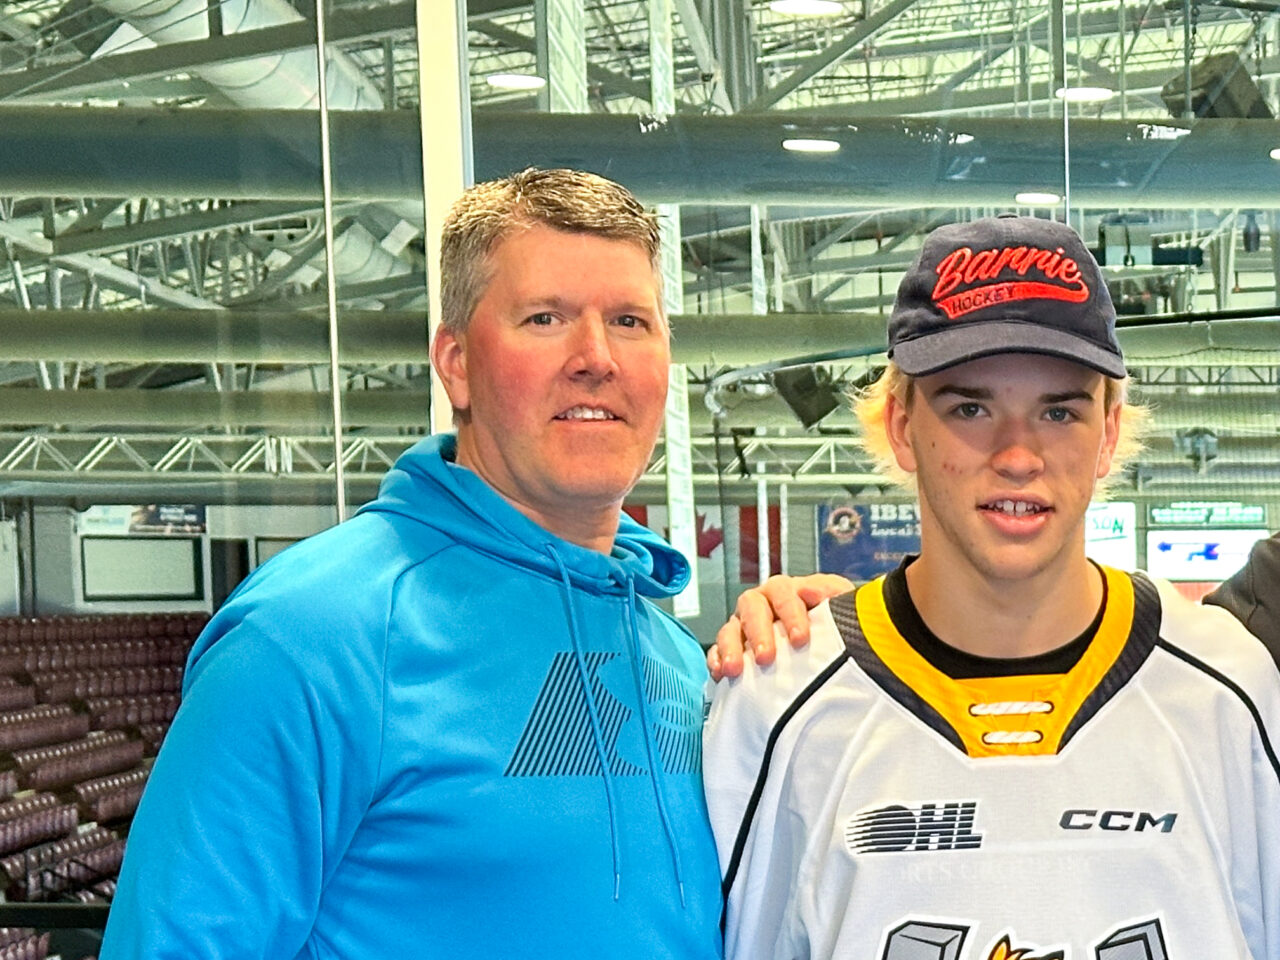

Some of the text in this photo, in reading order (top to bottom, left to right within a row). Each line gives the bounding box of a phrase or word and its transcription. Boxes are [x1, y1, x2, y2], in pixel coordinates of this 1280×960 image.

[932, 246, 1082, 300] Barrie
[952, 286, 1015, 314] HOCKEY
[846, 802, 982, 855] OHL
[1059, 809, 1178, 833] CCM
